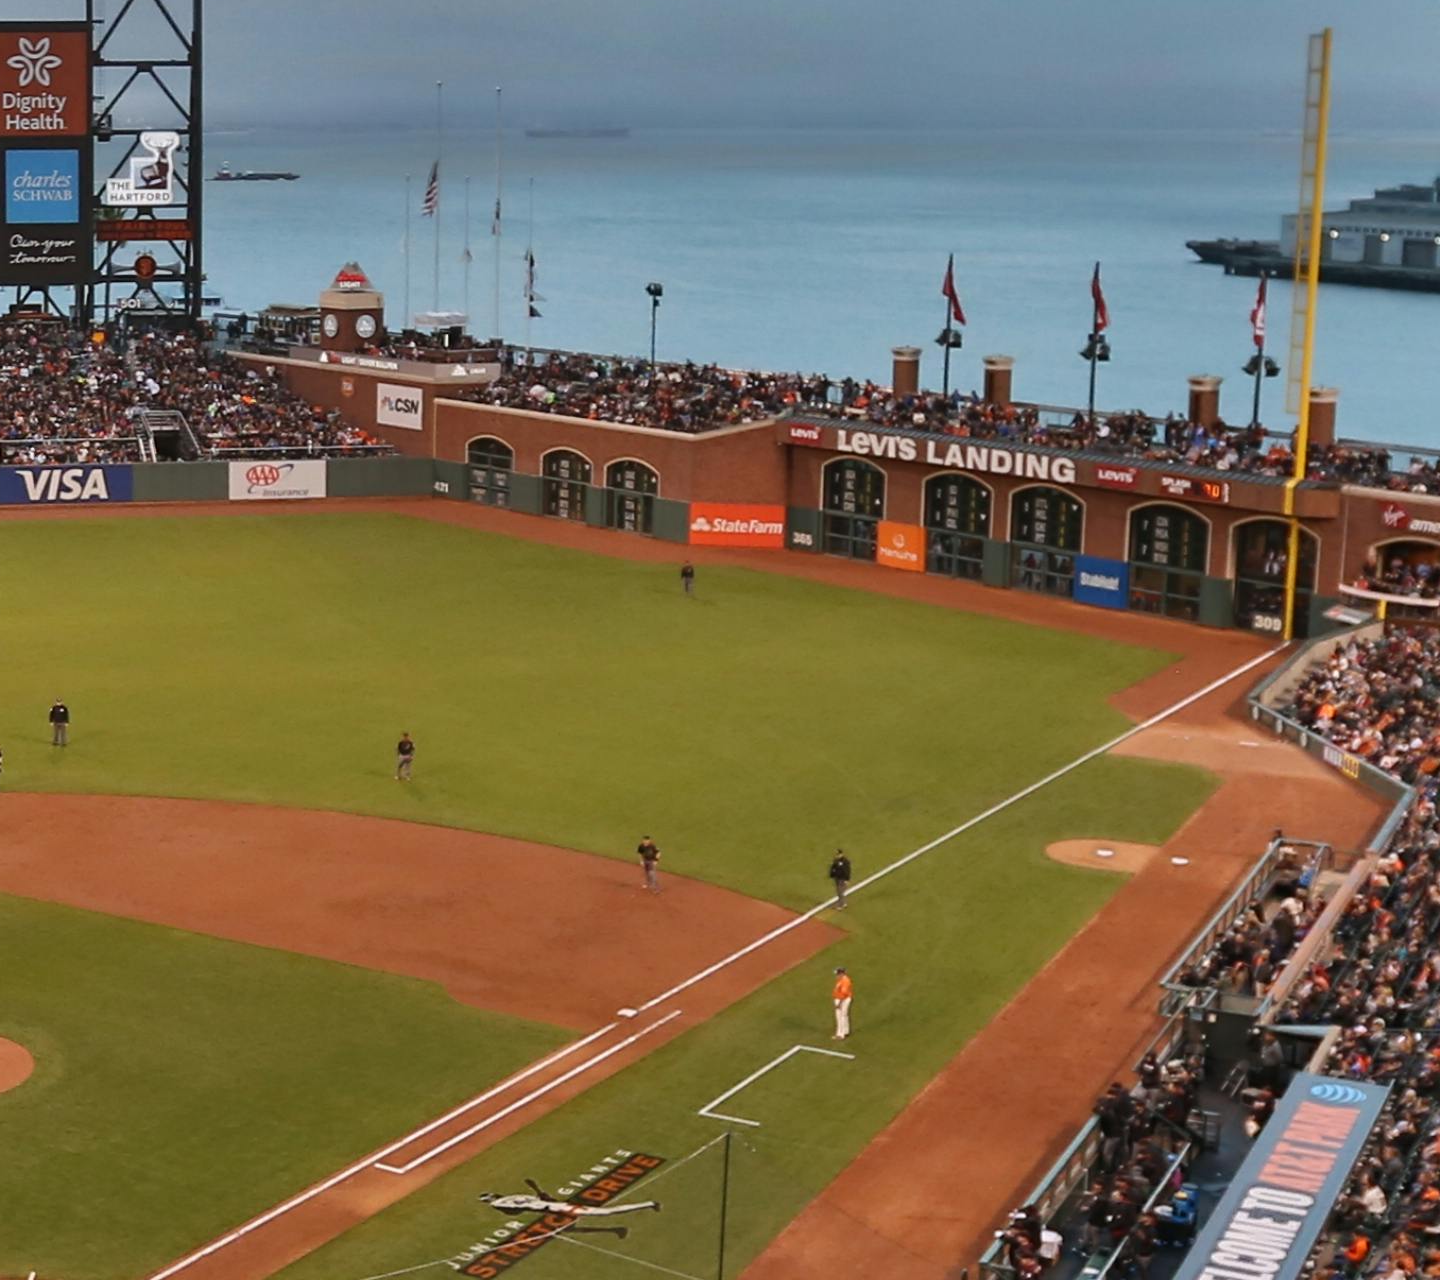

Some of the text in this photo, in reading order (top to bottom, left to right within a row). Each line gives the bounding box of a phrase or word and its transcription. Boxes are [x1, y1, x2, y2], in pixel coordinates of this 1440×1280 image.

[2, 93, 67, 115] Dignity
[6, 115, 65, 130] Health
[14, 170, 71, 187] charles
[111, 182, 130, 191] THE
[13, 190, 72, 201] SCHWAB
[110, 193, 170, 202] HARTFORD
[395, 398, 420, 414] CSN
[926, 440, 1076, 484] LANDING
[248, 468, 279, 485] AAA
[1162, 477, 1191, 488] SPLASH
[15, 469, 109, 501] VISA
[261, 485, 308, 496] Insurance
[434, 481, 449, 493] 421
[712, 518, 784, 535] State Farm
[793, 531, 813, 546] 365
[1254, 615, 1281, 631] 309
[558, 1149, 633, 1197] GIANTS
[580, 1154, 660, 1201] DRIVE
[1240, 1186, 1314, 1217] TO
[446, 1220, 525, 1271] JUNIOR
